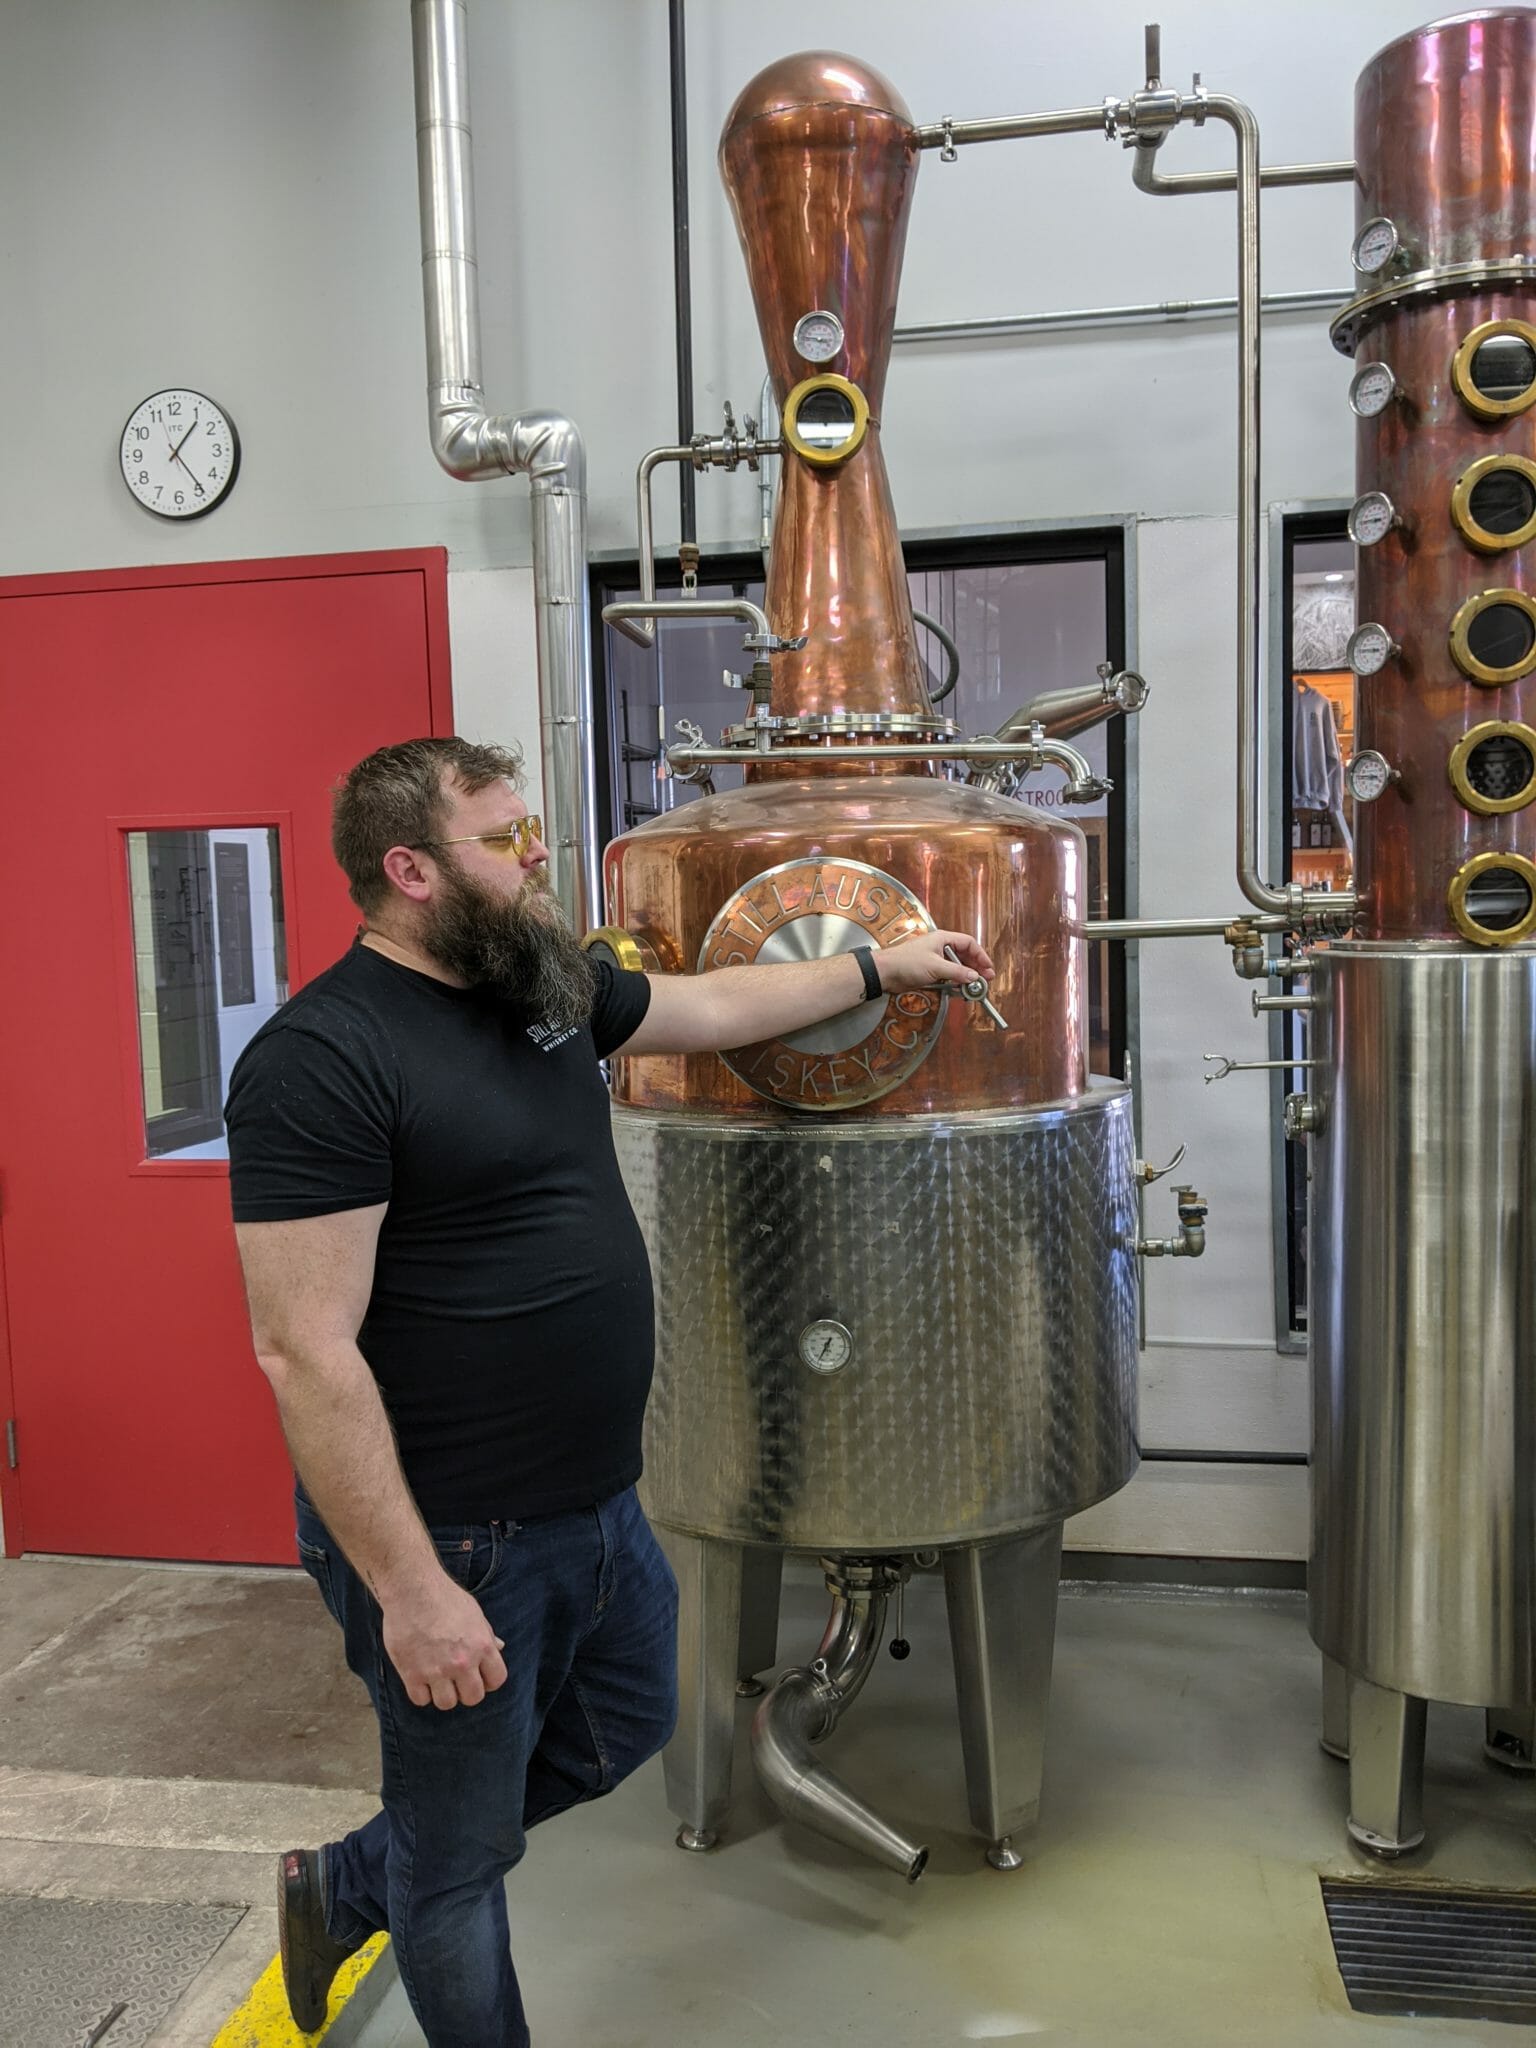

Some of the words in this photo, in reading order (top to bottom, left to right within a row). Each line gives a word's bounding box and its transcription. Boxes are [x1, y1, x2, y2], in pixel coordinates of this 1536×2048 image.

[150, 409, 162, 423] 11
[167, 401, 182, 416] 12
[193, 407, 199, 420] 1
[135, 426, 150, 441] 10
[206, 421, 216, 436] 2
[132, 449, 143, 463] 9
[211, 443, 222, 458] 3
[139, 470, 150, 485] 8
[208, 466, 218, 480] 4
[154, 486, 164, 500] 7
[174, 490, 185, 505] 6
[194, 482, 204, 498] 5
[713, 881, 800, 967] STILL
[808, 873, 919, 946] AUSTI
[526, 1022, 551, 1044] STILL
[735, 1047, 880, 1098] ISKEY
[884, 990, 931, 1049] CO
